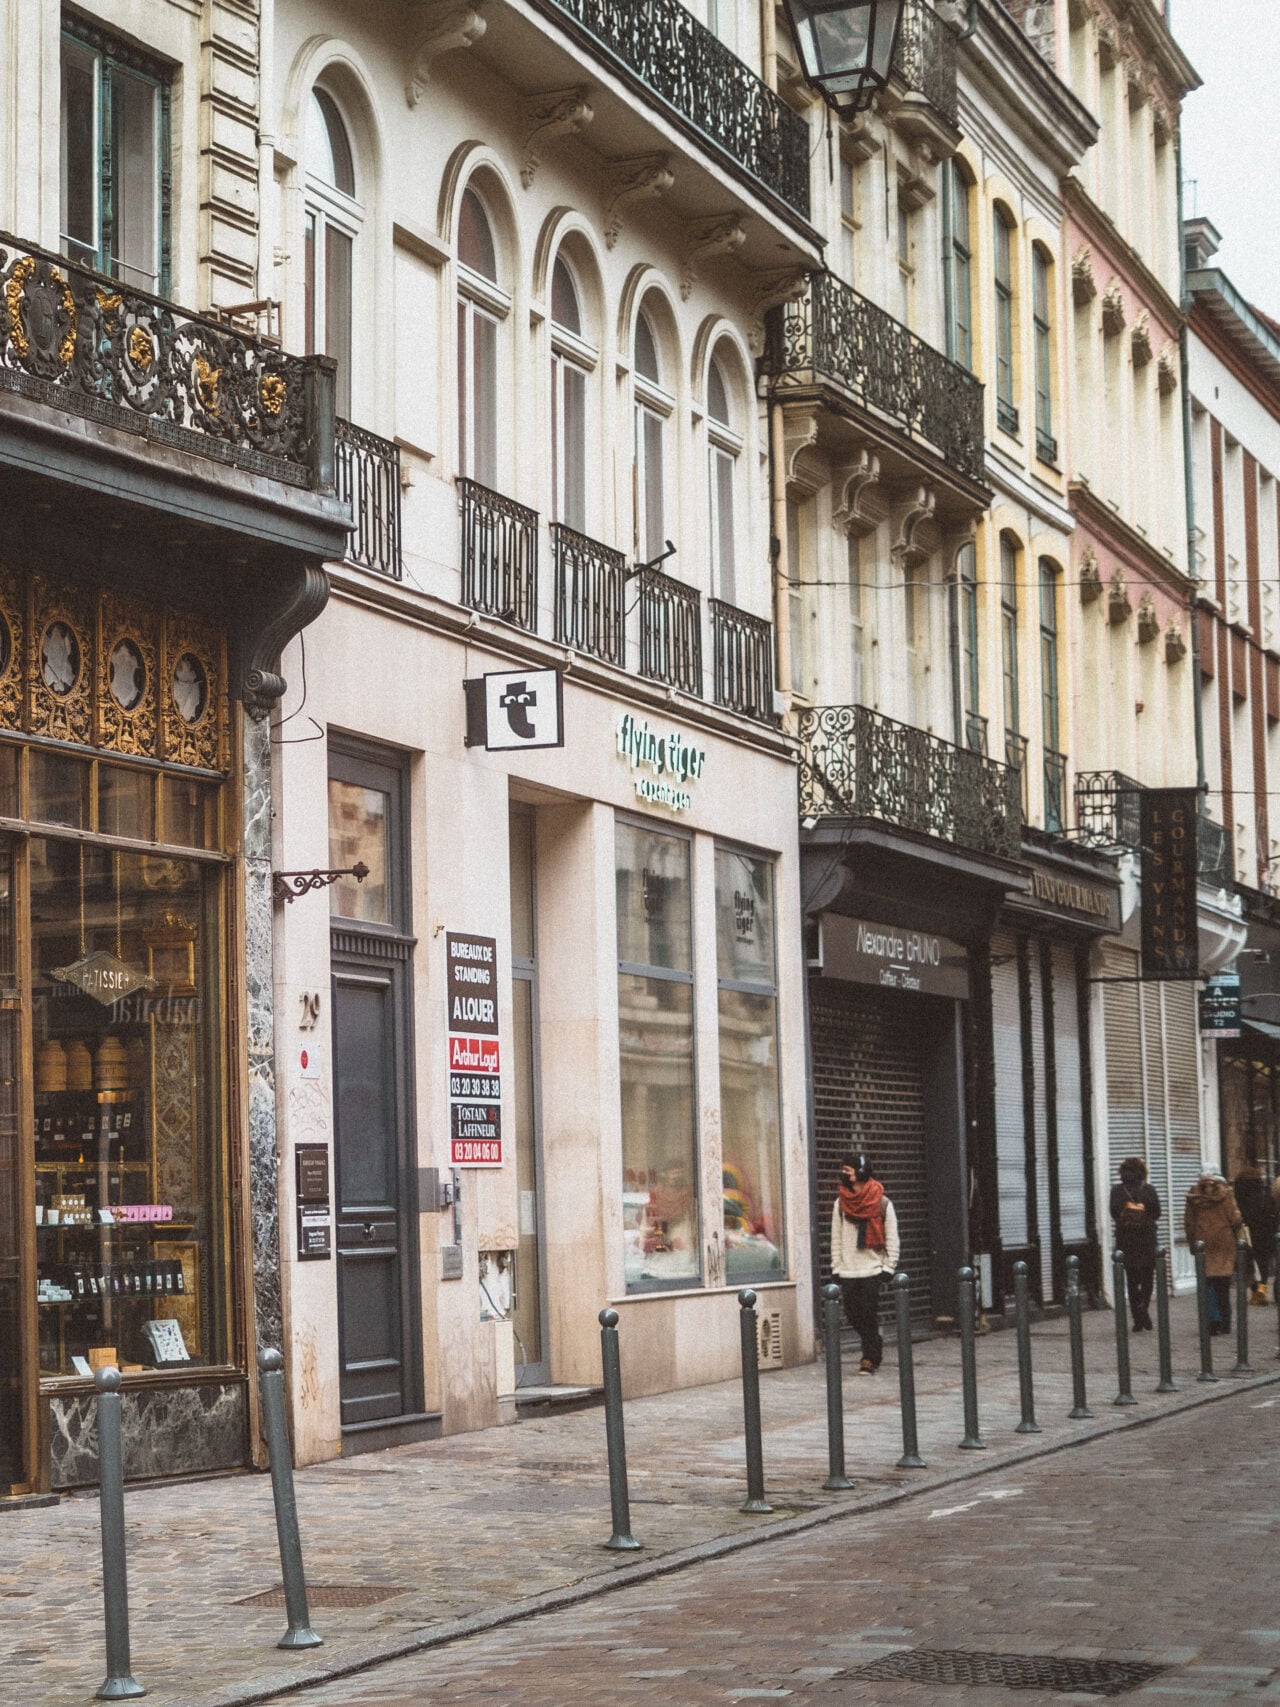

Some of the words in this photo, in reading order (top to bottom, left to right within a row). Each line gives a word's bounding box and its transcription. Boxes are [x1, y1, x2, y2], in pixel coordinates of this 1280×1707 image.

[617, 714, 666, 774] flying
[667, 733, 706, 783] tiger
[1170, 808, 1187, 959] GOURMANDS
[451, 942, 483, 961] BUREAUX
[483, 946, 493, 963] DE
[454, 965, 490, 985] STANDING
[299, 991, 320, 1032] 29
[462, 997, 495, 1023] LOUER
[452, 1038, 480, 1067] Arthur
[479, 1038, 498, 1072] Loyd
[451, 1077, 461, 1095] 03
[461, 1077, 471, 1095] 20
[471, 1078, 481, 1096] 30
[481, 1078, 491, 1096] 38
[490, 1079, 500, 1097] 38
[456, 1104, 487, 1121] TOSTAIN
[458, 1120, 496, 1137] LAFFINEUR
[454, 1142, 464, 1160] 03
[464, 1142, 473, 1160] 20
[472, 1142, 482, 1160] 04
